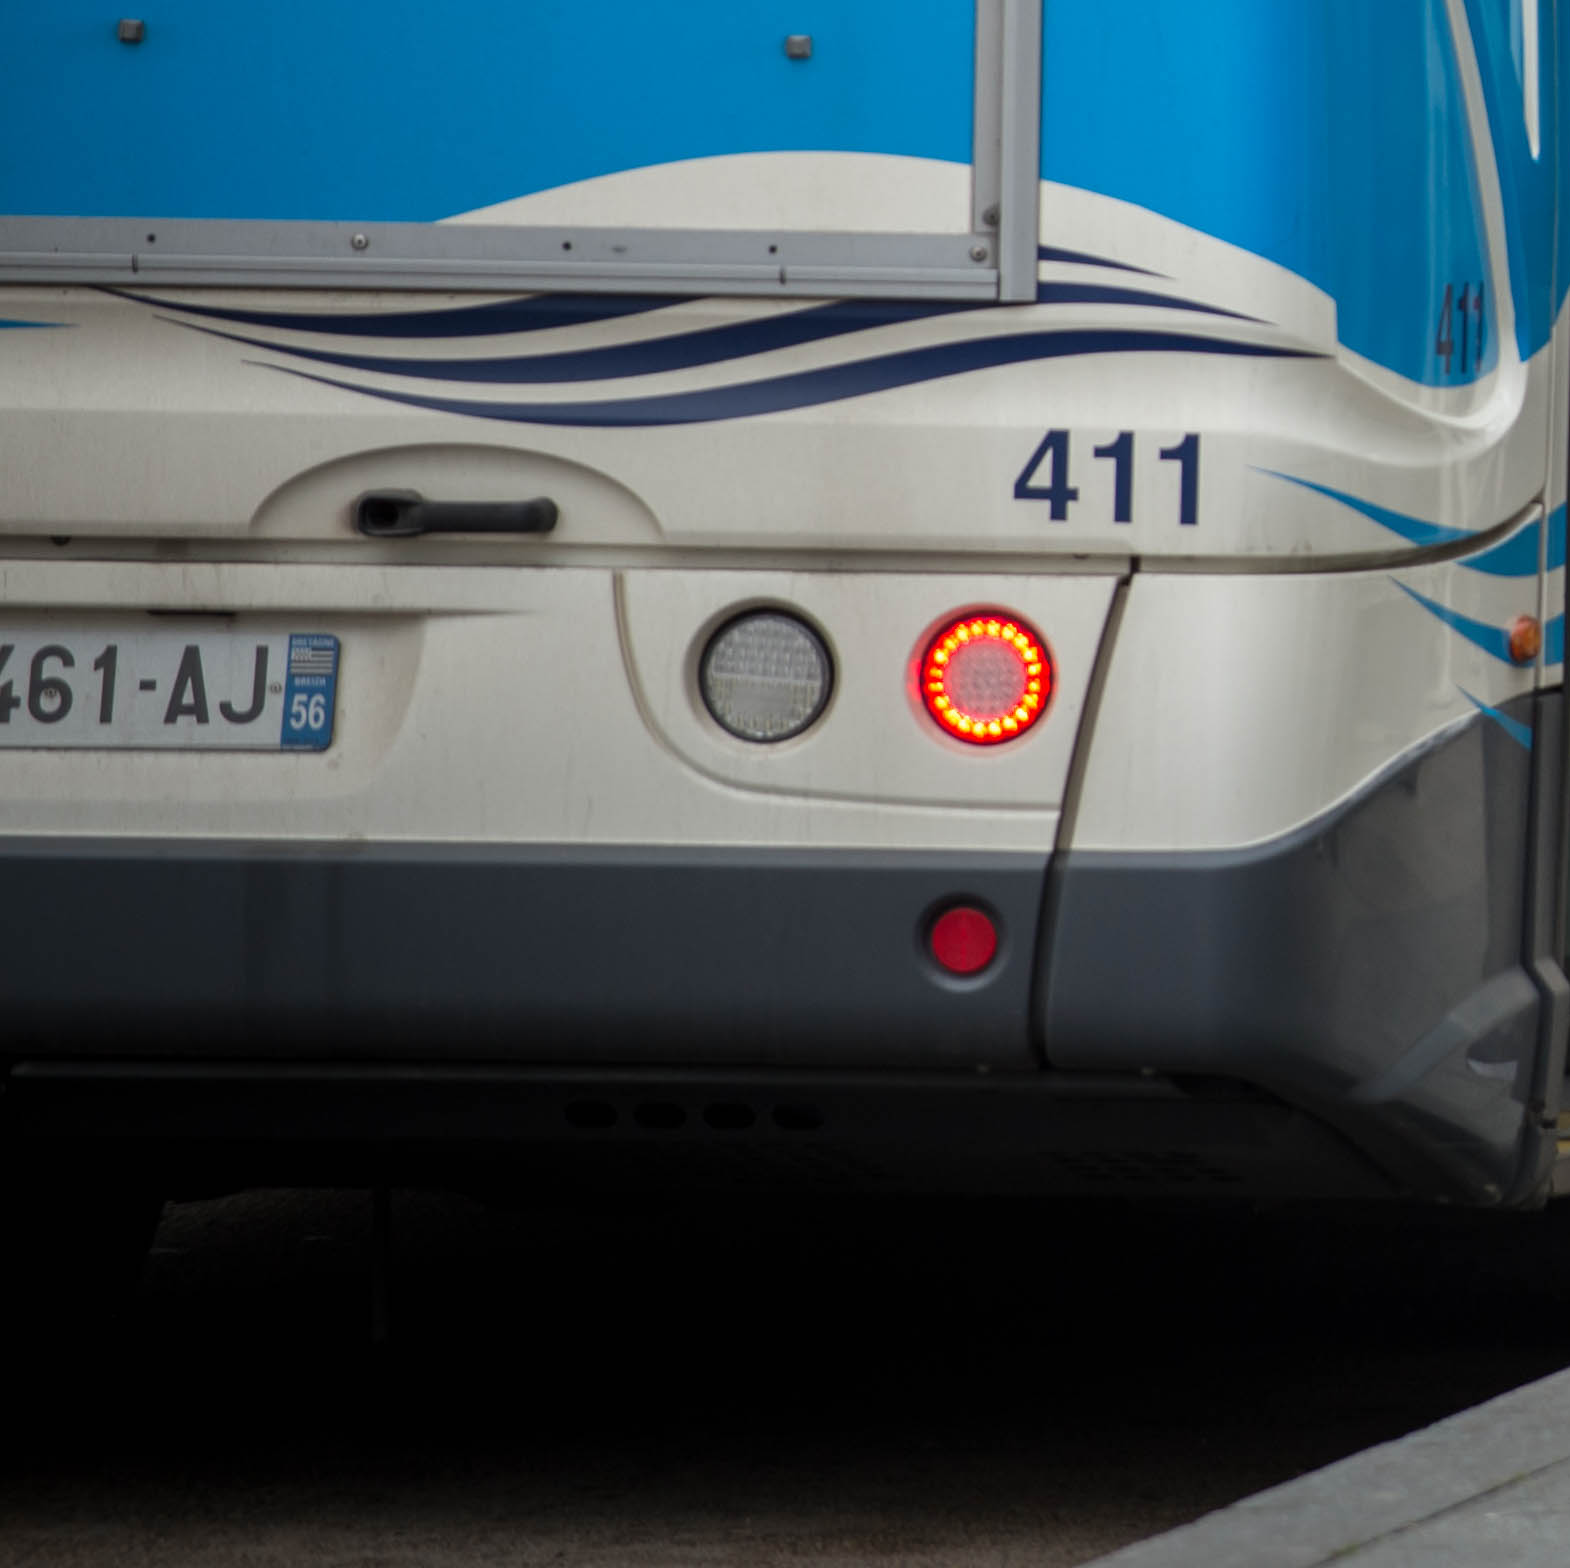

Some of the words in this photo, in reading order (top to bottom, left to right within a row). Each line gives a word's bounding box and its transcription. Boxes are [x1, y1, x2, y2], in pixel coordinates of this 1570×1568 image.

[1436, 281, 1484, 375] 411
[1013, 428, 1201, 525] 411
[289, 692, 326, 731] 56
